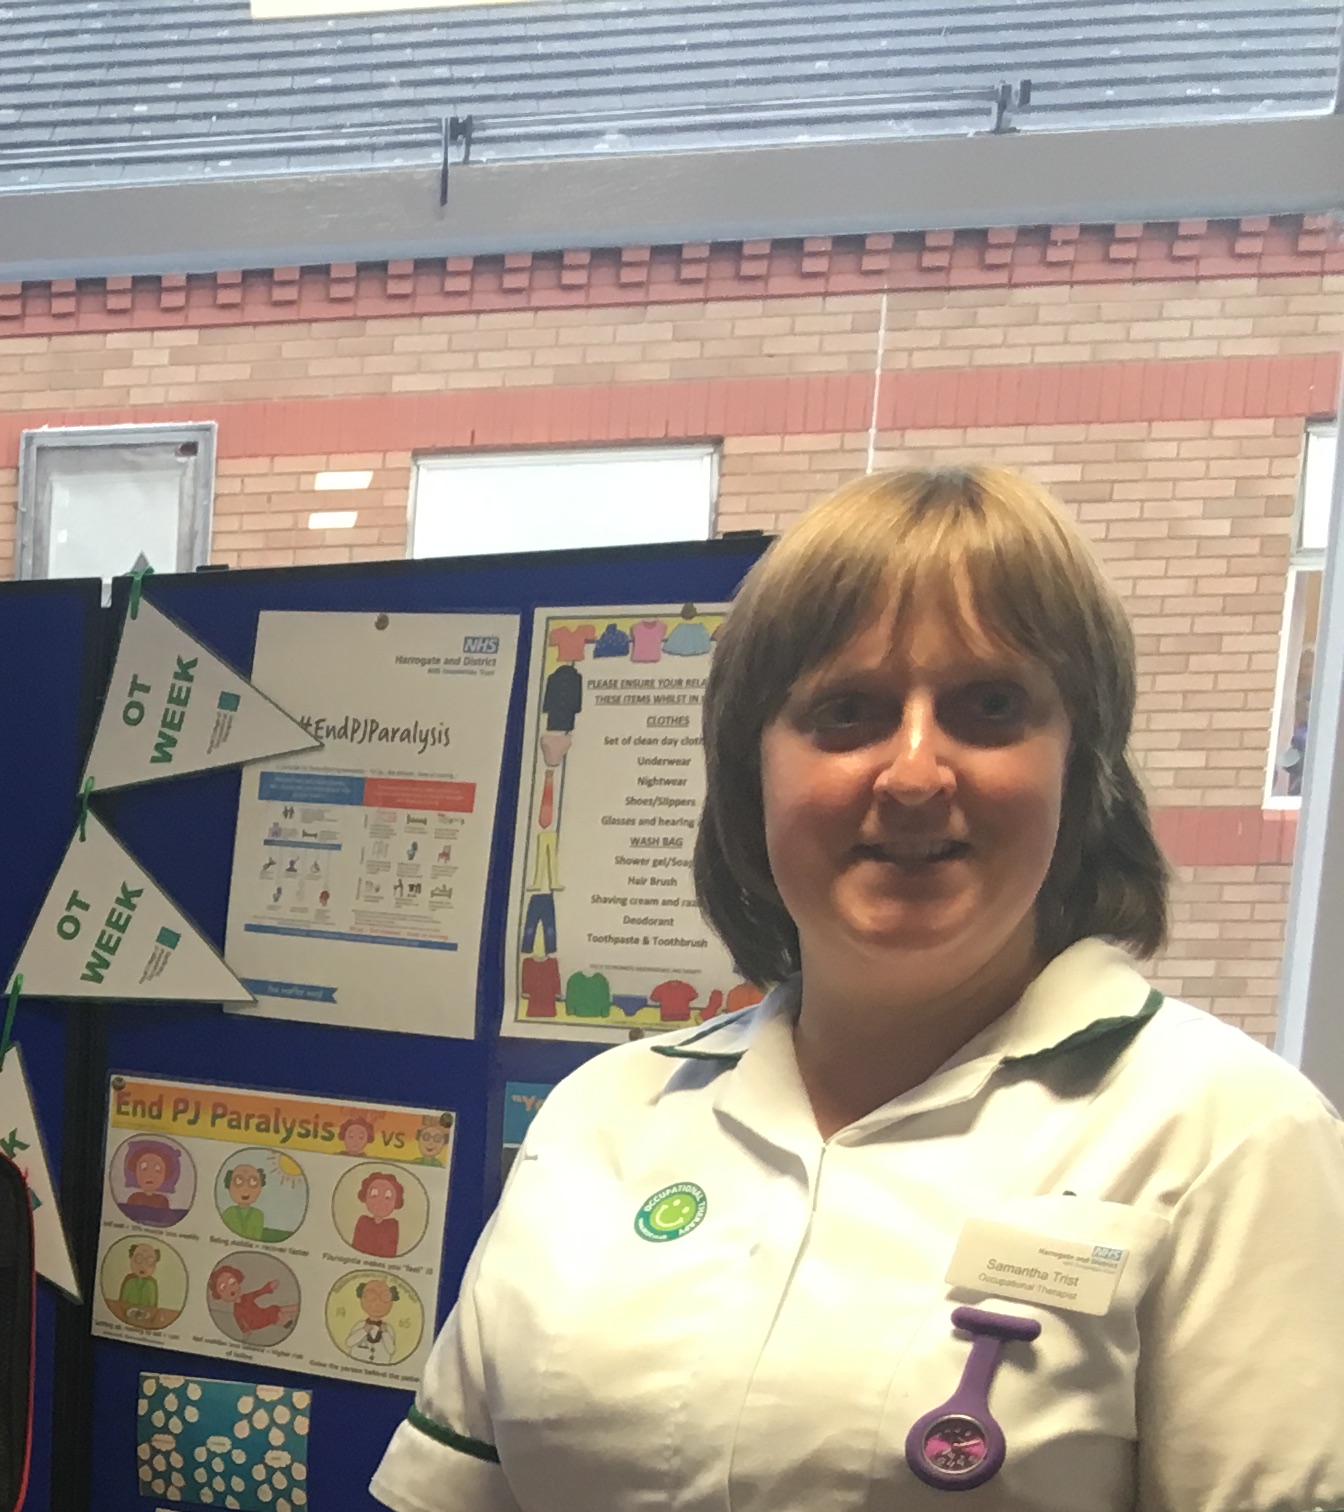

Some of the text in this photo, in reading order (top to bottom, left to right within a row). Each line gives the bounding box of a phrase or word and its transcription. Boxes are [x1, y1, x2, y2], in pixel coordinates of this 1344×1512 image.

[464, 636, 499, 653] NHS
[395, 655, 496, 667] Harrogate and District
[587, 680, 618, 688] PLEASE
[621, 679, 656, 688] ENSURE
[658, 679, 683, 687] YOUR
[123, 673, 151, 726] OT
[595, 695, 621, 704] THESE
[624, 695, 651, 704] ITEMS
[654, 696, 688, 704] WHILST
[150, 655, 198, 763] WEEK
[647, 716, 690, 726] CLOTHES
[604, 736, 619, 745] Set
[621, 736, 632, 745] of
[634, 736, 659, 745] clean
[661, 736, 679, 747] day
[637, 756, 691, 766] Underwear
[637, 776, 688, 788] Nightwear
[625, 796, 696, 808] Shoes/Slippers
[601, 816, 695, 828] Glasses and hearing
[630, 837, 684, 847] WASH BAG
[614, 855, 650, 866] Shower
[628, 876, 678, 887] Hair Brush
[591, 894, 627, 907] Shaving
[629, 897, 659, 906] cream
[662, 897, 679, 907] and
[57, 889, 91, 940] OT
[623, 915, 674, 926] Deodorant
[80, 880, 144, 984] WEEK
[587, 933, 708, 948] Toothpaste & Toothbrush
[116, 1091, 164, 1120] End
[172, 1097, 201, 1126] PJ
[210, 1101, 335, 1144] Paralysis
[1092, 1245, 1123, 1261] NHS
[986, 1258, 1049, 1281] Samantha
[1053, 1271, 1079, 1287] Trist
[978, 1272, 1078, 1300] Occupational Therapist
